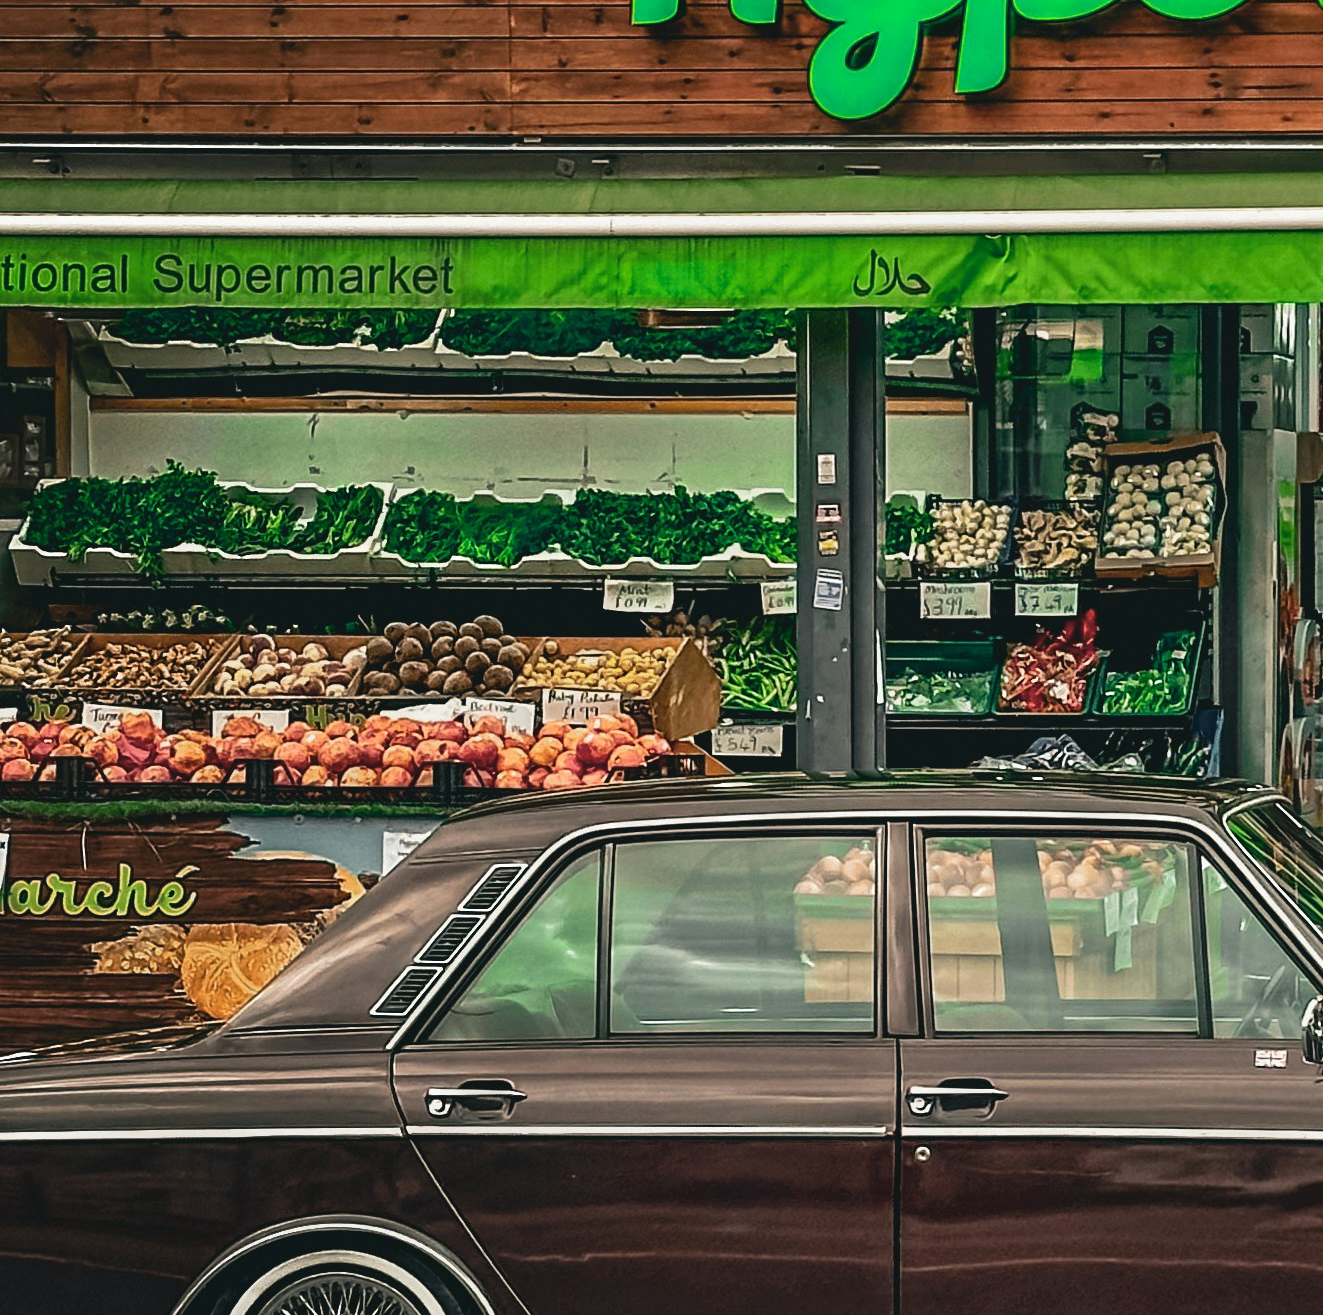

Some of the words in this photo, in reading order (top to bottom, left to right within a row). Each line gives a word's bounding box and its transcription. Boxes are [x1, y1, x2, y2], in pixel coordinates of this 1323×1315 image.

[153, 253, 454, 302] Supermarket
[852, 249, 932, 297] حلال
[0, 863, 200, 917] arché
